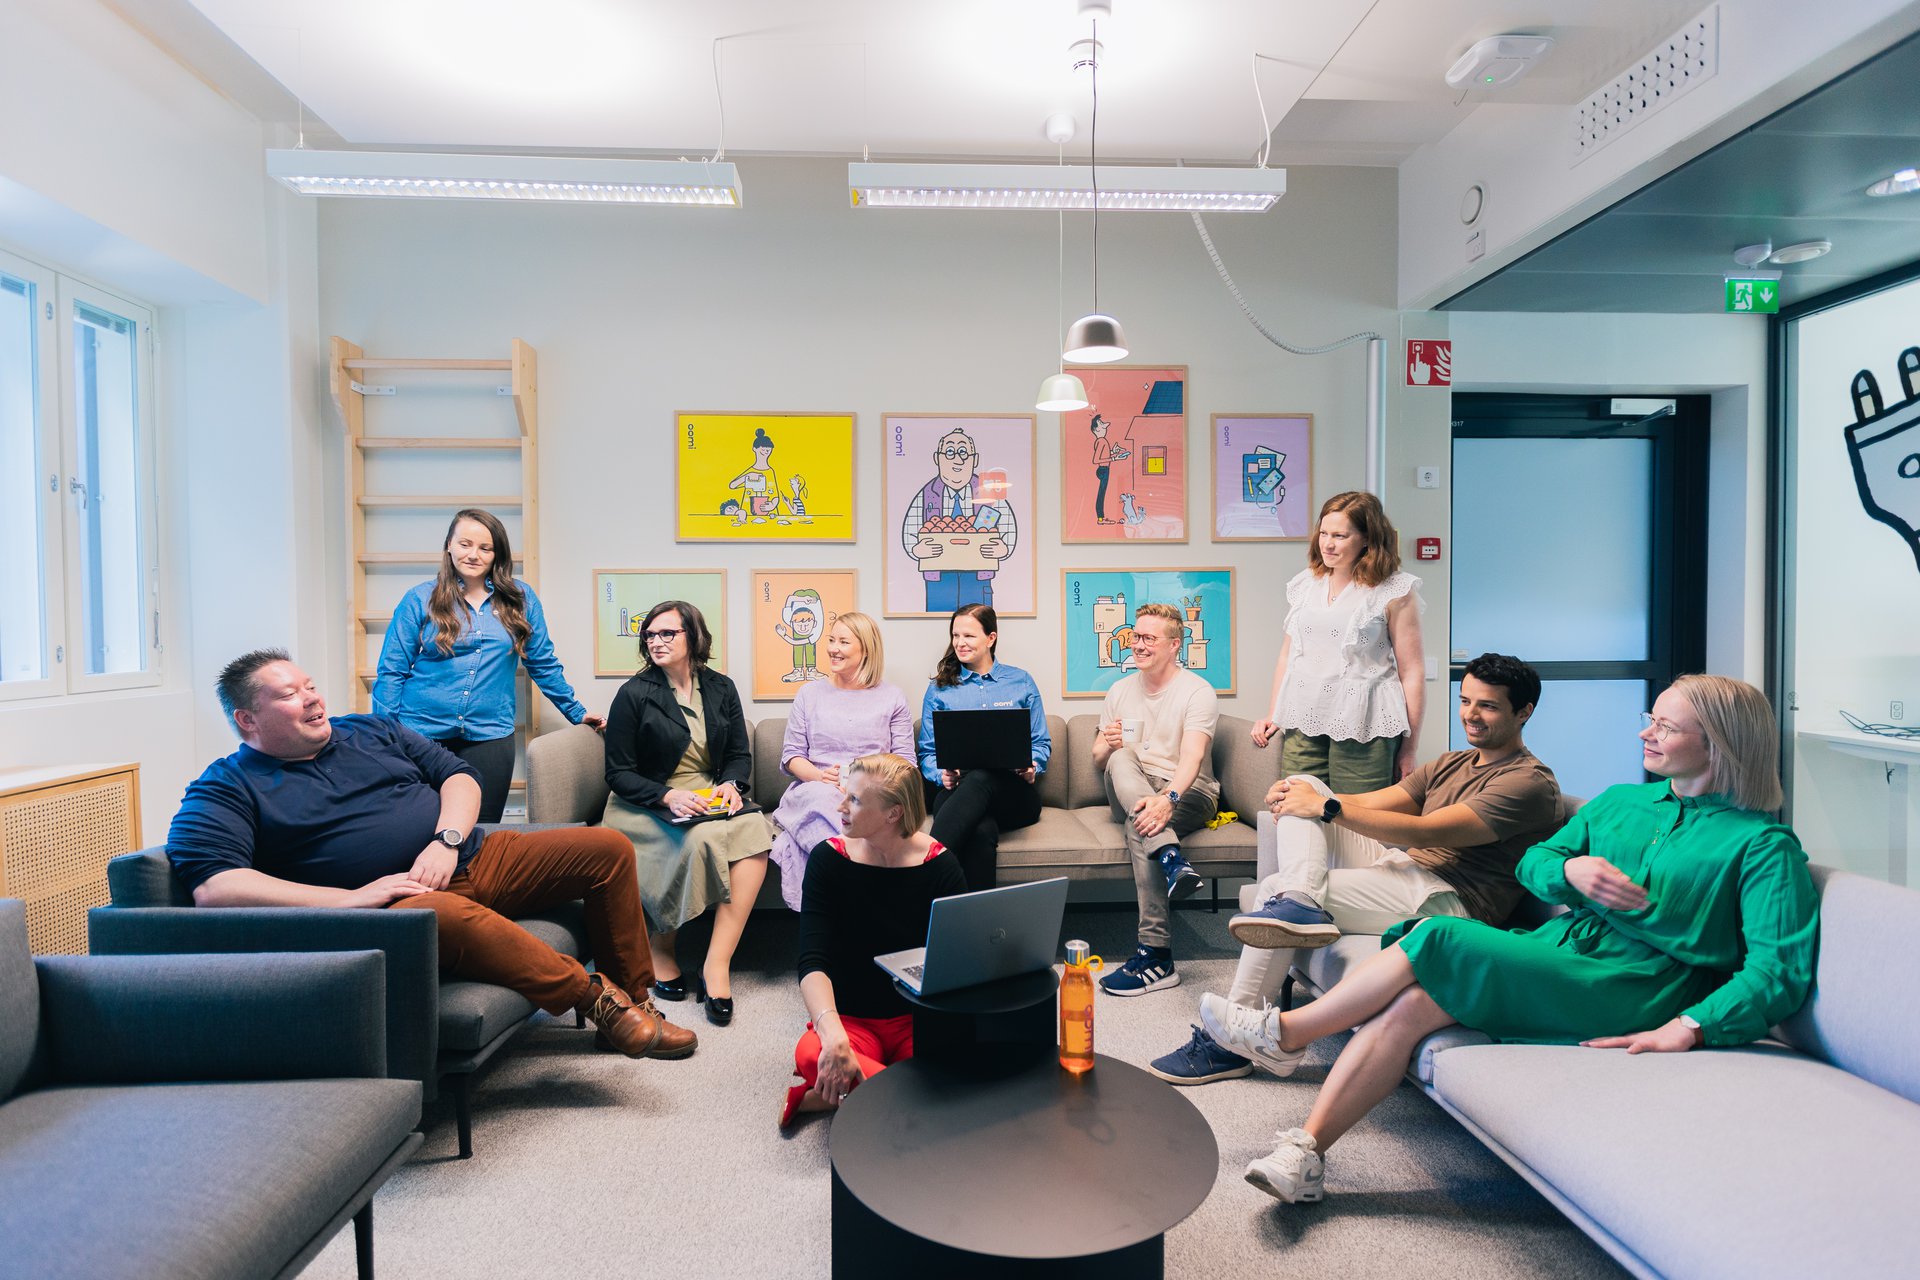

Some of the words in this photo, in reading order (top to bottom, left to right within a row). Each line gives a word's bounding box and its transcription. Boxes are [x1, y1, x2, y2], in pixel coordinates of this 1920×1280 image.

[687, 423, 697, 450] oomi
[895, 425, 906, 457] oomi
[606, 582, 614, 602] oomi
[764, 581, 772, 603] oomi
[1073, 580, 1083, 606] oomi
